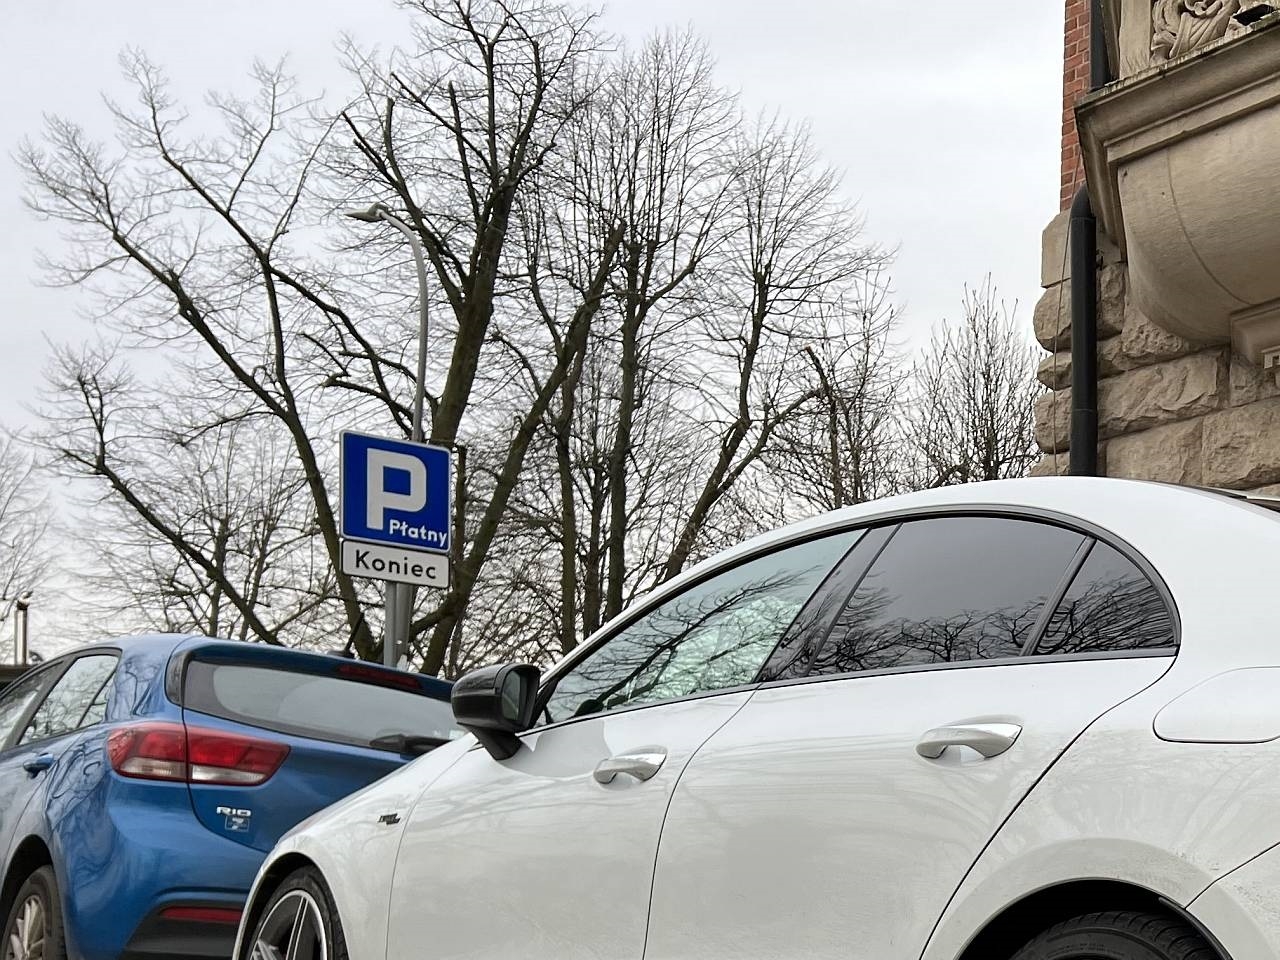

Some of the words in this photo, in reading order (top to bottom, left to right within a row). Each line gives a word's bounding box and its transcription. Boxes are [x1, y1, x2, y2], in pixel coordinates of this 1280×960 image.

[366, 447, 427, 531] P
[389, 518, 447, 547] Płatny
[355, 549, 436, 579] Koniec
[216, 806, 252, 817] RIO
